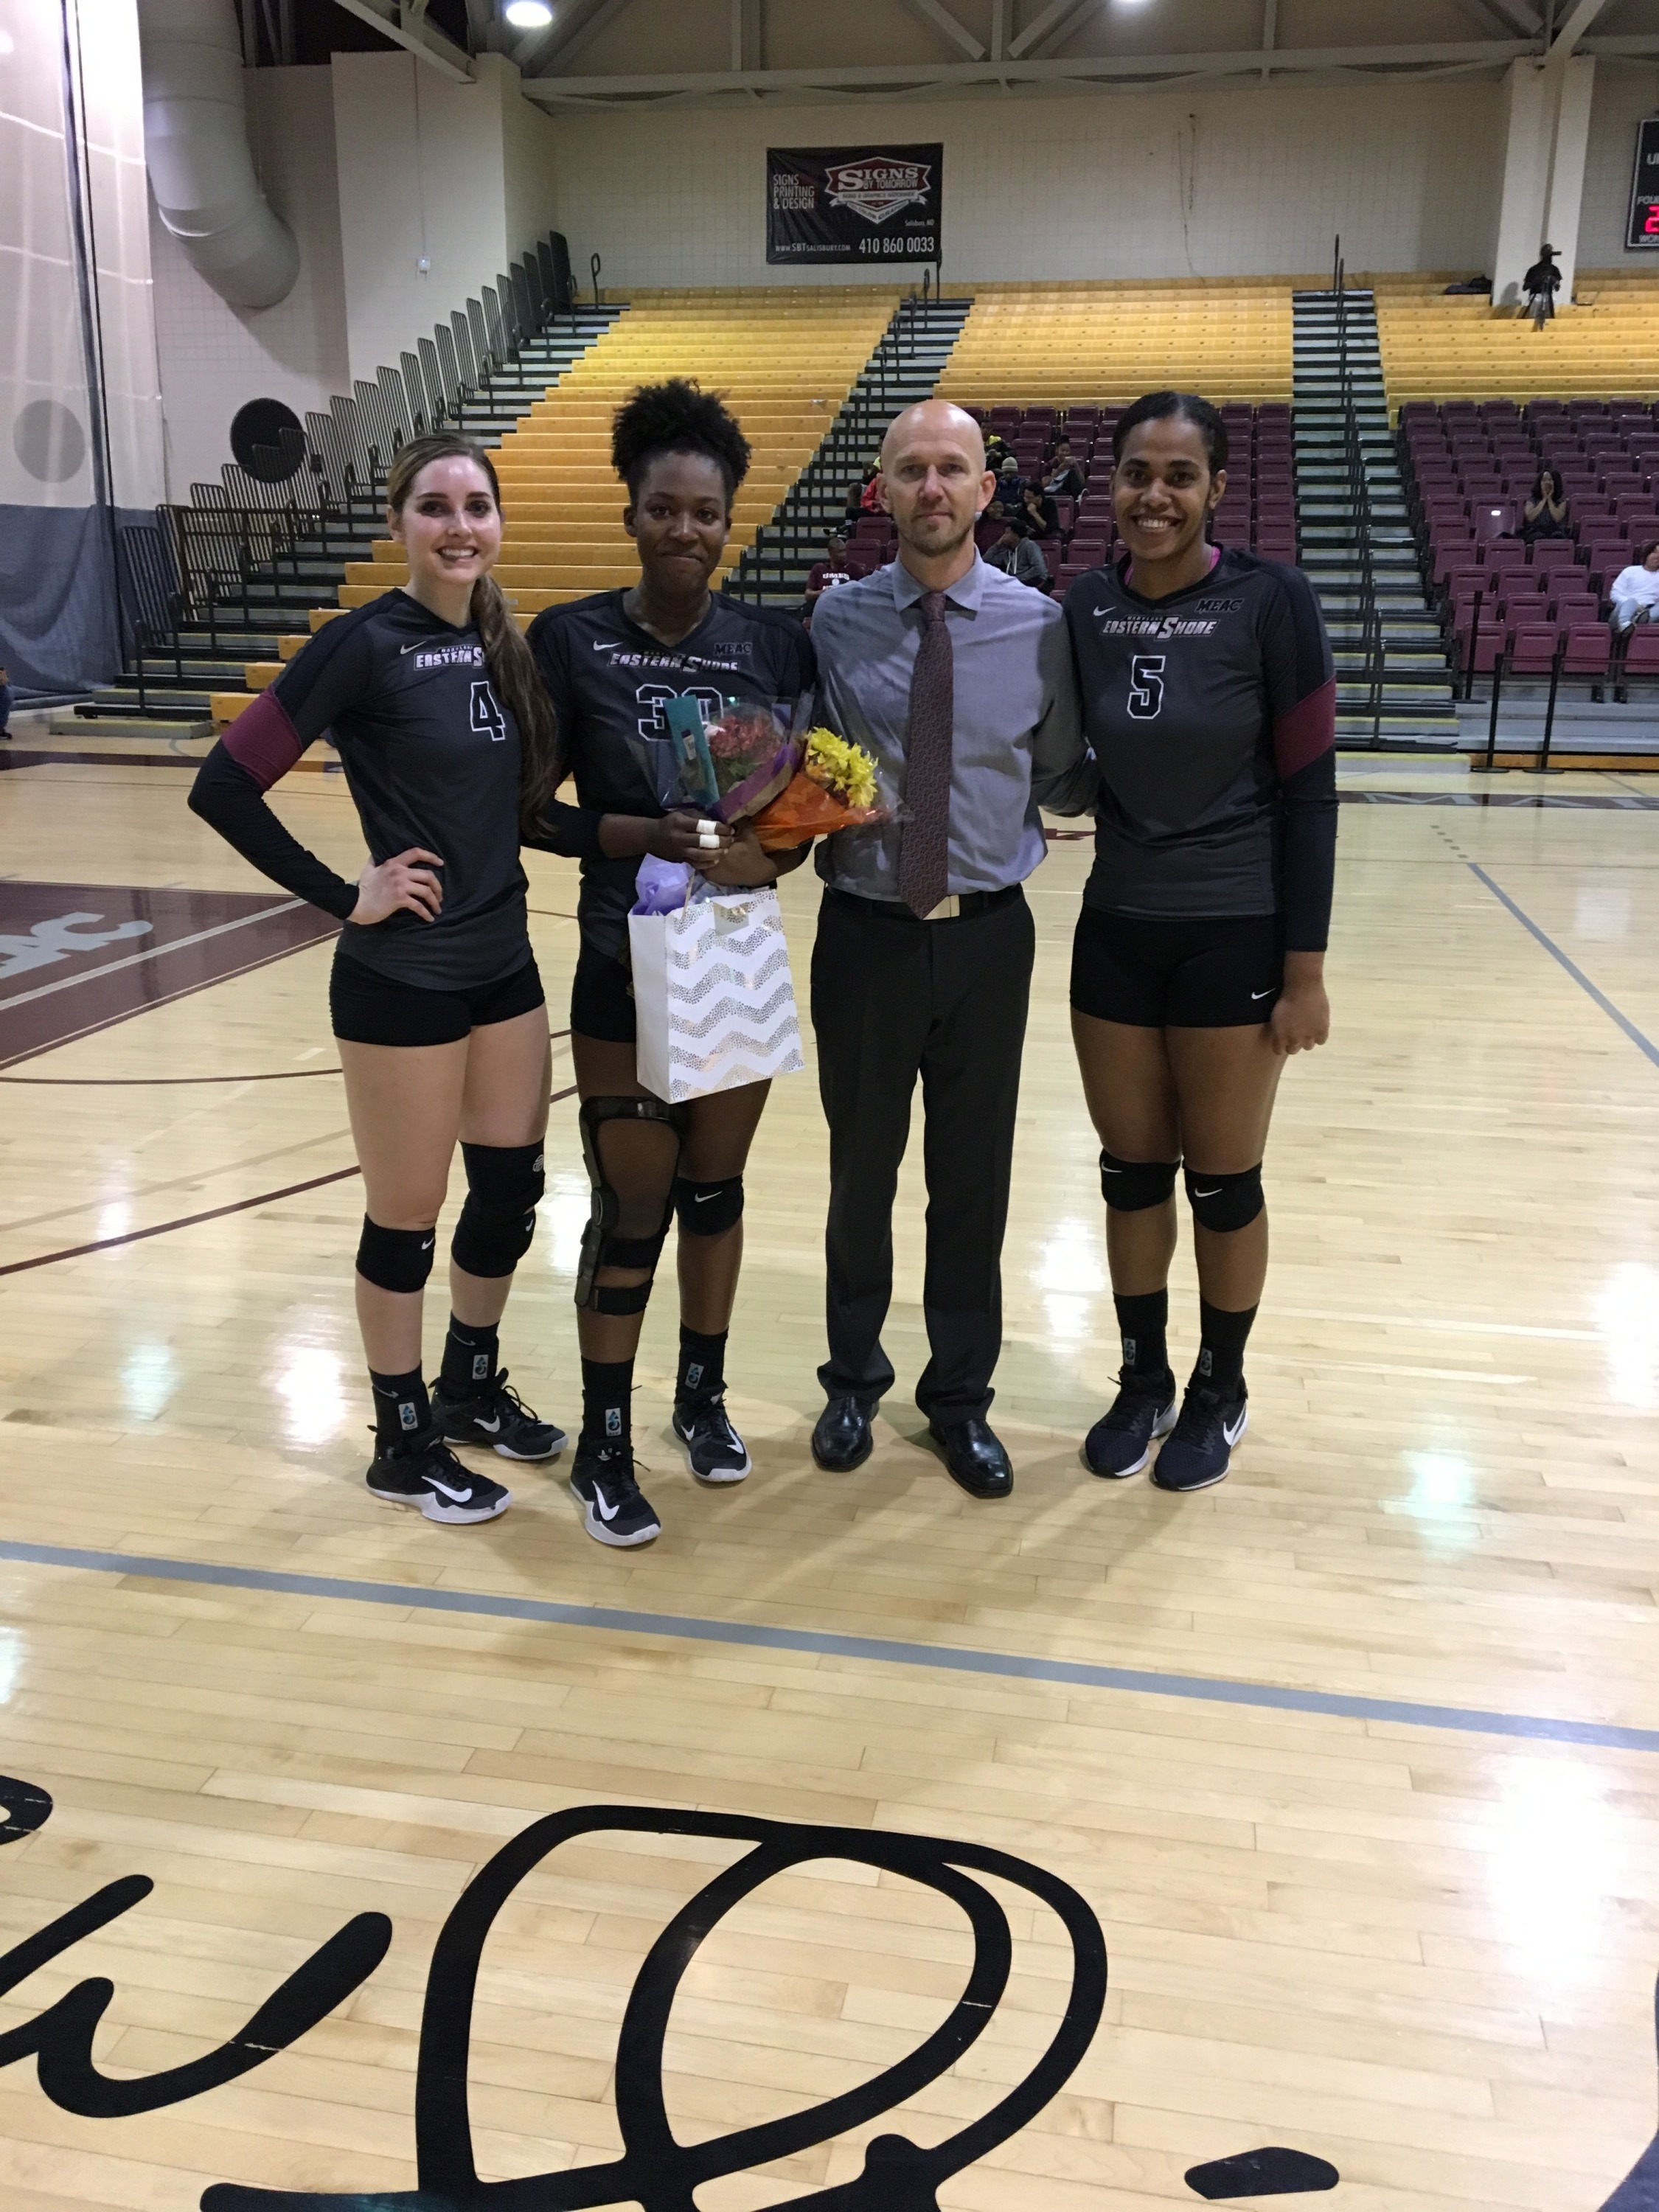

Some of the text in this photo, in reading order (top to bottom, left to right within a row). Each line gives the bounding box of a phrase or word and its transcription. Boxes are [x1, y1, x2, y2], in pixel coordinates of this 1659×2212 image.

[773, 174, 799, 185] SIGNS
[838, 168, 919, 190] SIGNS
[863, 178, 918, 189] BY TOMORROW
[773, 186, 815, 197] PRINTING
[773, 197, 815, 209] & DESIGN
[859, 237, 934, 253] 410 860 0033
[1196, 599, 1244, 612] MEAC
[1102, 616, 1217, 639] EASTERN SHORE
[714, 643, 752, 655] MEAC
[610, 653, 683, 668] EASTERN
[1127, 655, 1166, 719] 5
[470, 681, 506, 741] 4
